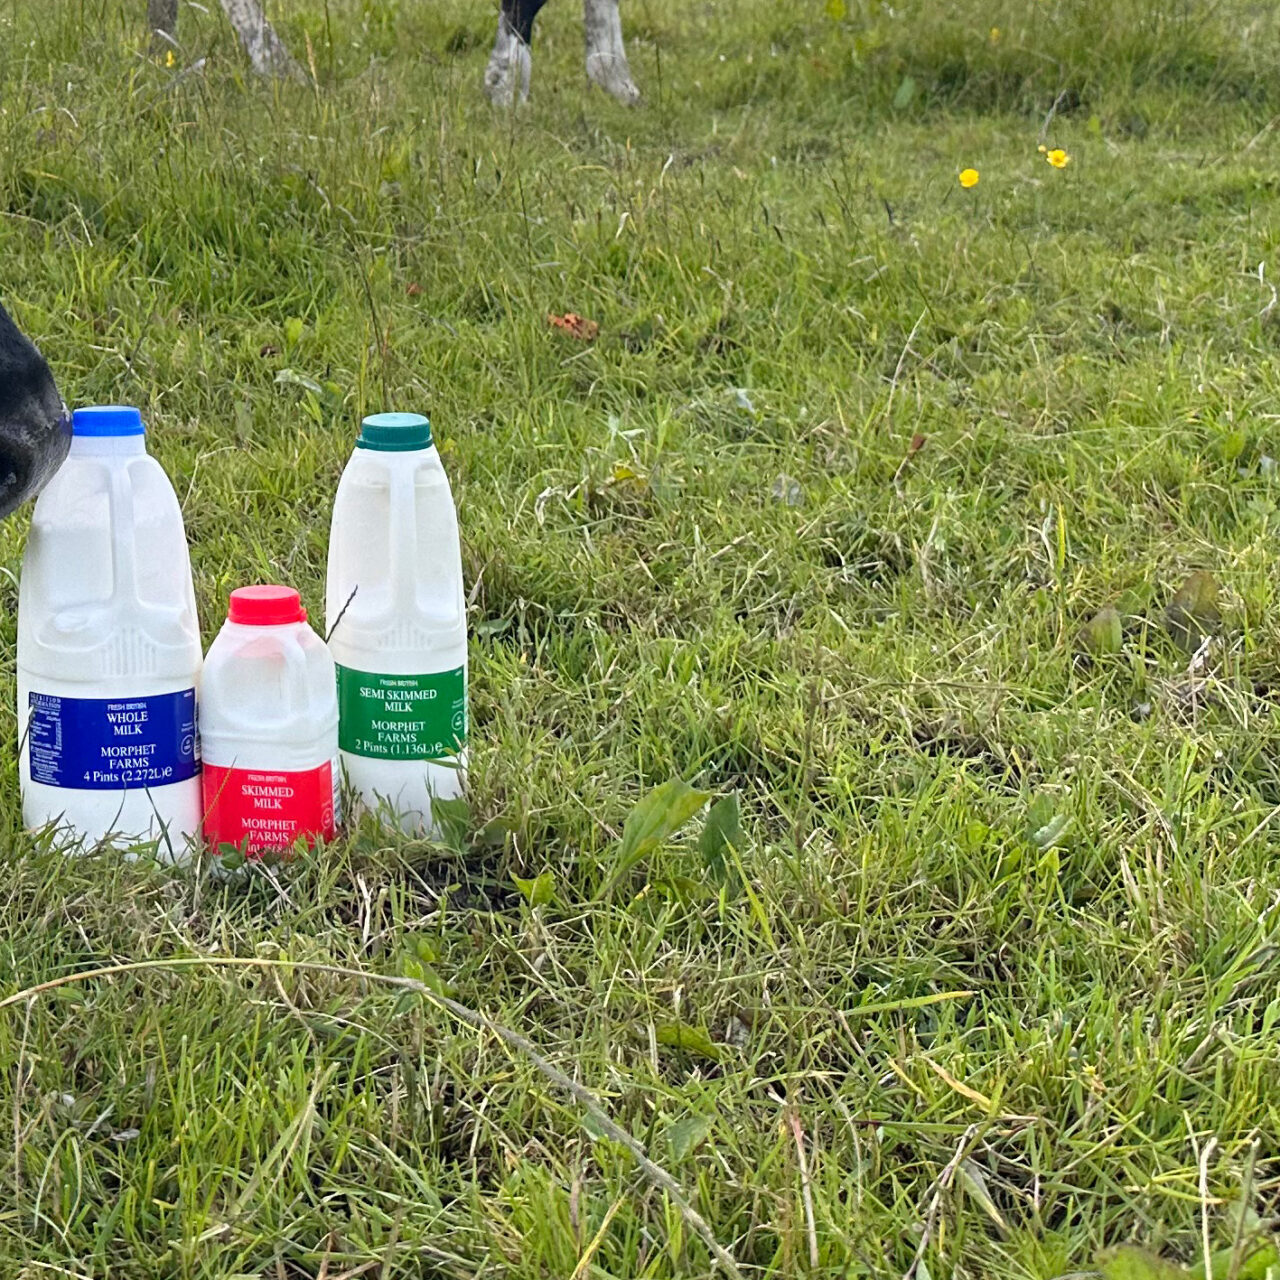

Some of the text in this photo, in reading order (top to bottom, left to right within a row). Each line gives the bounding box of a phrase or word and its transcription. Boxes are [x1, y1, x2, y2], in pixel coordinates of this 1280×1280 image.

[359, 687, 437, 700] SEMI SKIMMED
[385, 702, 413, 712] MILK
[107, 711, 148, 723] WHOLE
[113, 724, 143, 735] MILK
[371, 720, 426, 732] MORPHET
[378, 733, 417, 743] FARMS
[101, 744, 156, 757] MORPHET
[355, 739, 361, 749] 2
[363, 740, 387, 753] Pints
[109, 757, 149, 769] FARMS
[83, 770, 90, 780] 4
[93, 770, 119, 782] Pints
[241, 785, 294, 797] SKIMMED
[254, 798, 282, 809] MILK
[241, 818, 297, 830] MORPHET
[249, 831, 289, 842] FARMS
